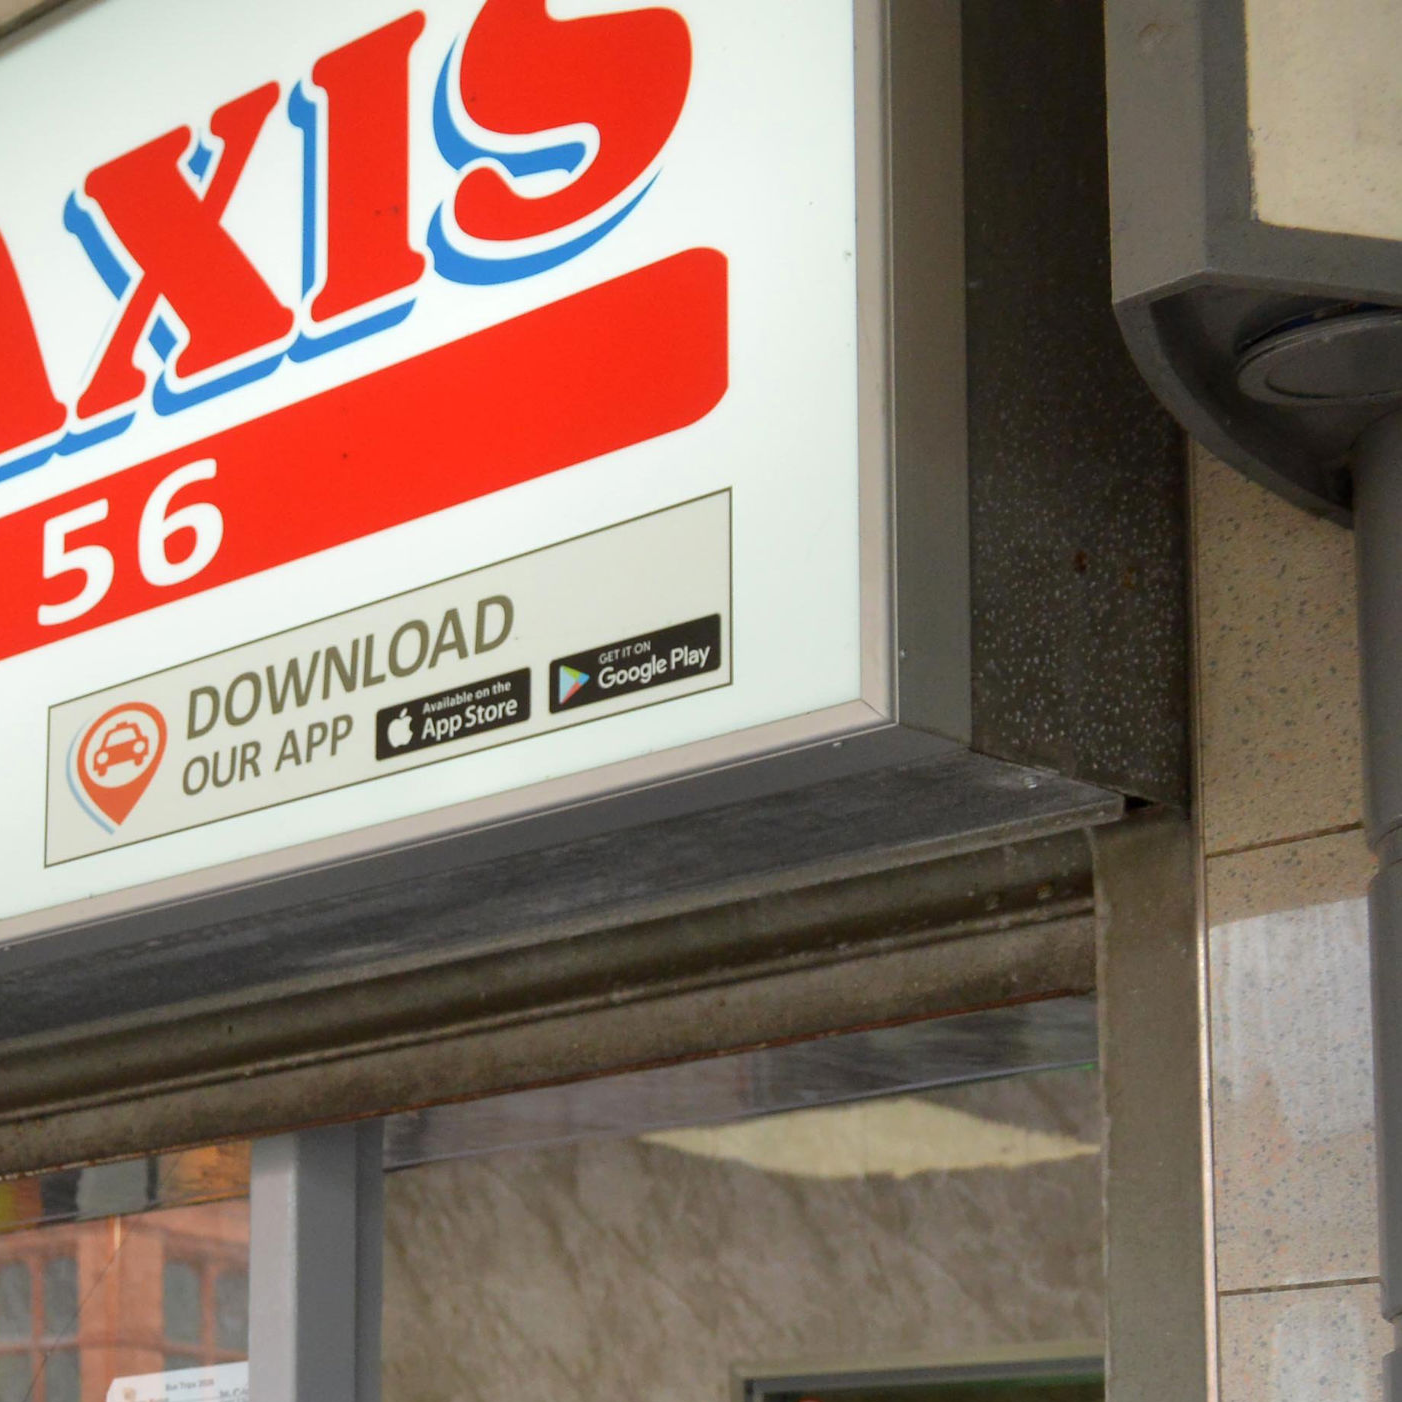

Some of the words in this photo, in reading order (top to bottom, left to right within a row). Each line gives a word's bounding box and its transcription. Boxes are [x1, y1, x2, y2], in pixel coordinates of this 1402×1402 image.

[36, 457, 226, 627] 56
[186, 594, 515, 740] DOWNLOAD
[598, 649, 619, 665] GET
[620, 646, 632, 659] IT
[633, 639, 652, 656] ON
[598, 653, 667, 691] Google
[671, 644, 711, 671] Play
[421, 711, 461, 741] App
[464, 697, 518, 729] Store
[422, 690, 472, 715] Available
[475, 687, 490, 699] on
[493, 680, 512, 695] the
[182, 740, 261, 796] OUR
[274, 714, 353, 772] APP
